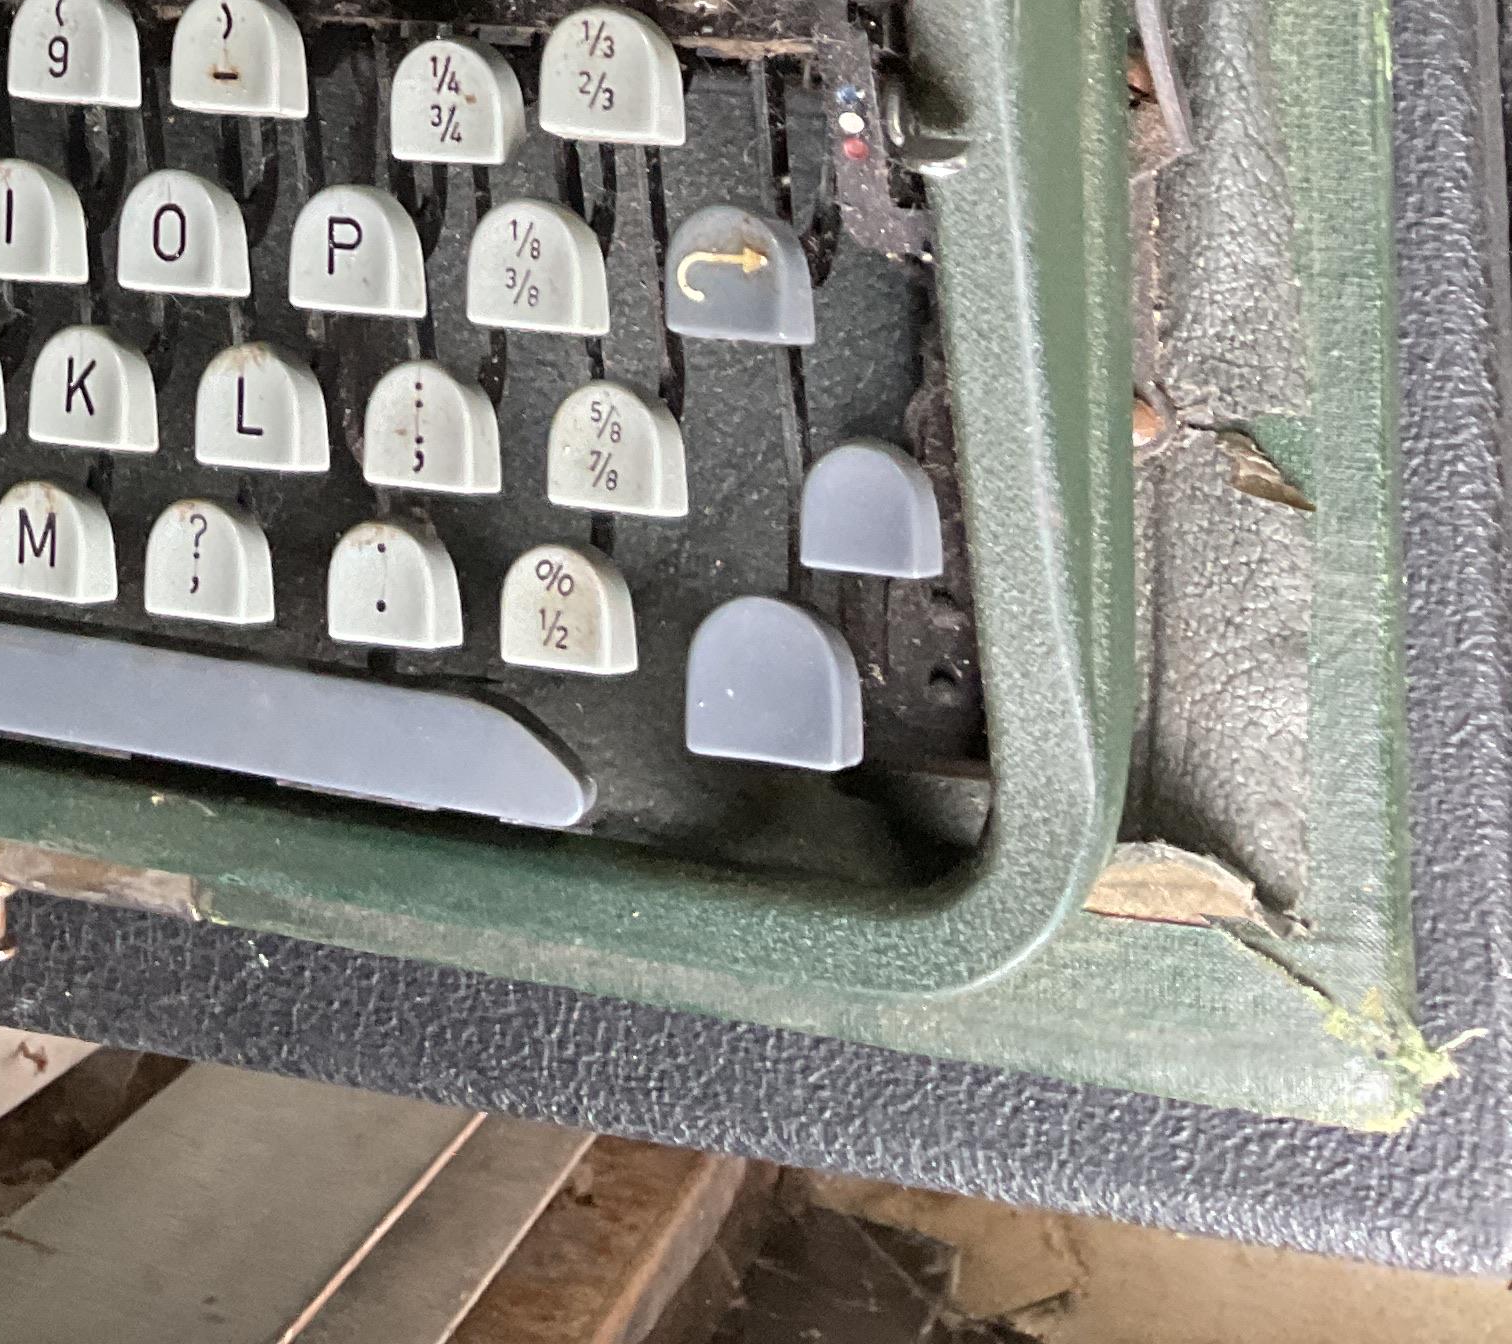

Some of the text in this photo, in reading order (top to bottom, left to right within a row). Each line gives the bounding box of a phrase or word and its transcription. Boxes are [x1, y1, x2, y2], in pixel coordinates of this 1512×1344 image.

[48, 35, 69, 79] 9
[5, 188, 14, 245] I
[153, 203, 187, 262] O
[327, 216, 363, 276] P
[65, 356, 97, 417] K
[236, 376, 264, 437] L
[18, 508, 57, 568] M
[189, 513, 208, 560] ?
